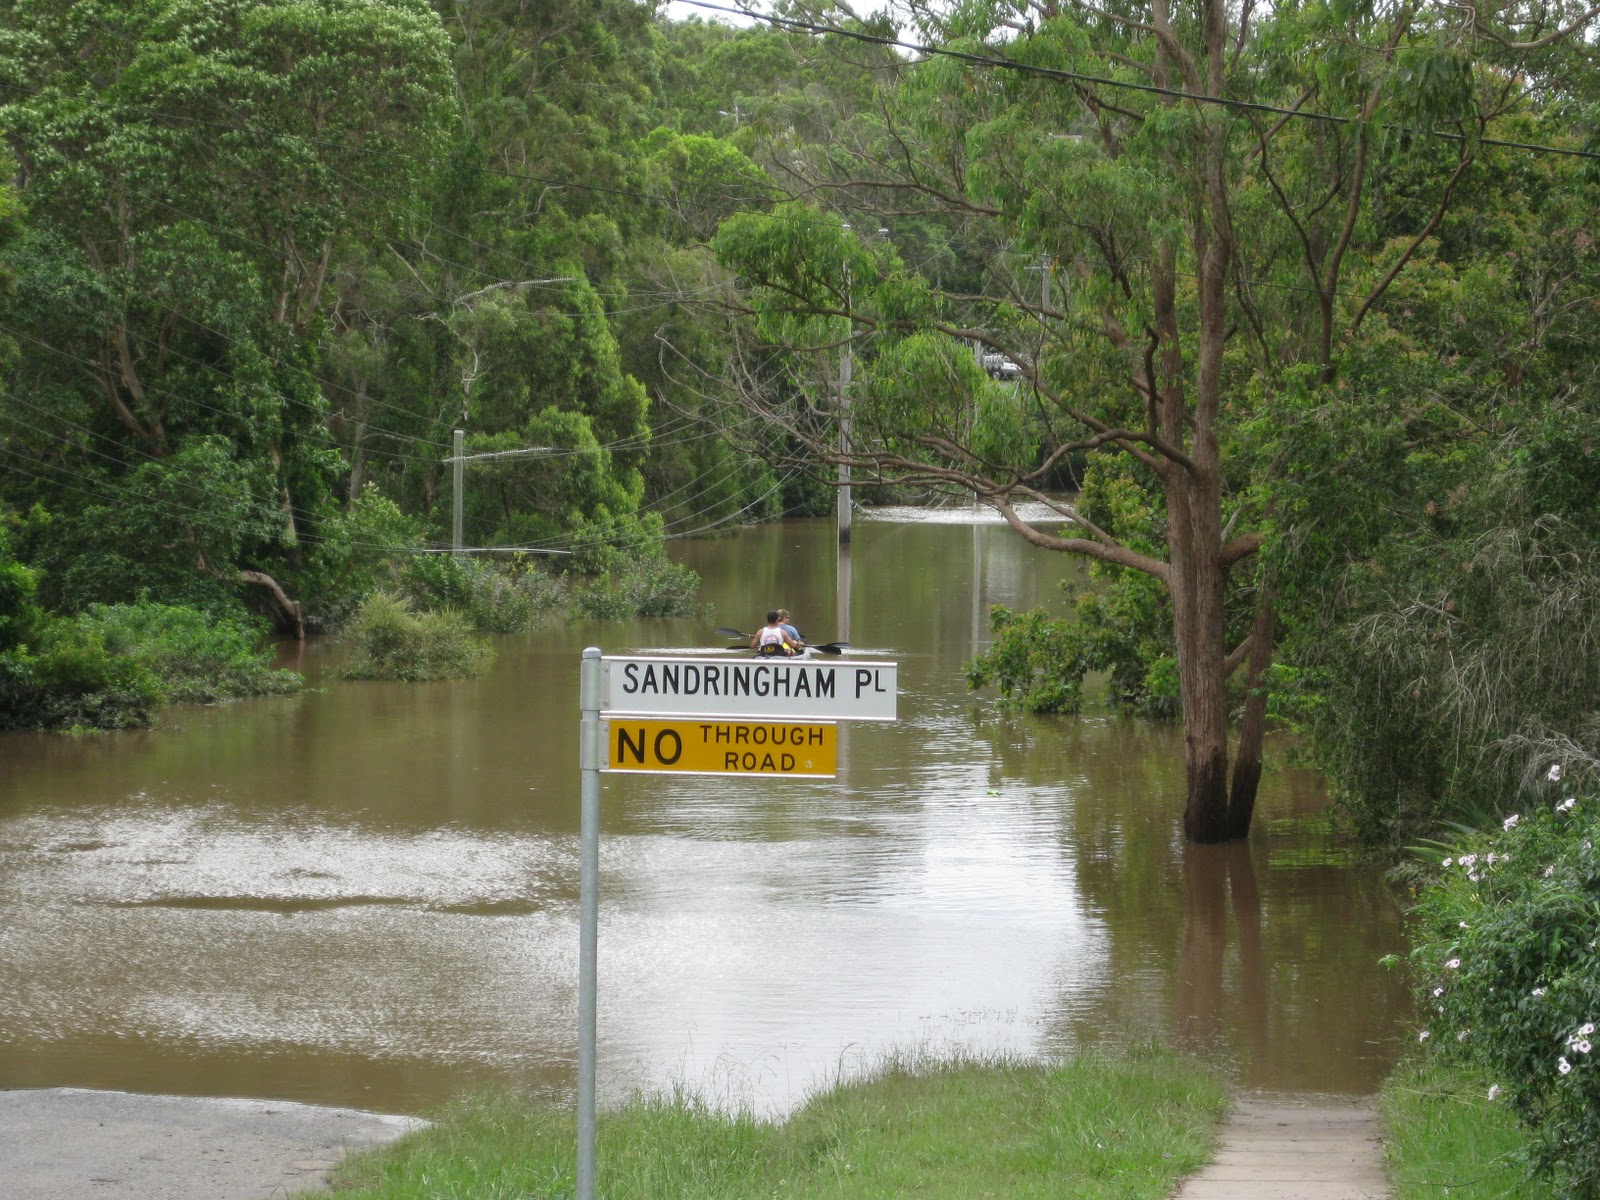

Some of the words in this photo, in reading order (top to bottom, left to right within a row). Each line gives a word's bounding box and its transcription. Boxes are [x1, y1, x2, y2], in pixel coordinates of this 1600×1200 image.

[622, 662, 836, 699] SANDRINGHAM
[855, 669, 887, 699] PL
[617, 727, 683, 766] NO
[699, 724, 824, 746] THROUGH
[724, 751, 796, 772] ROAD
